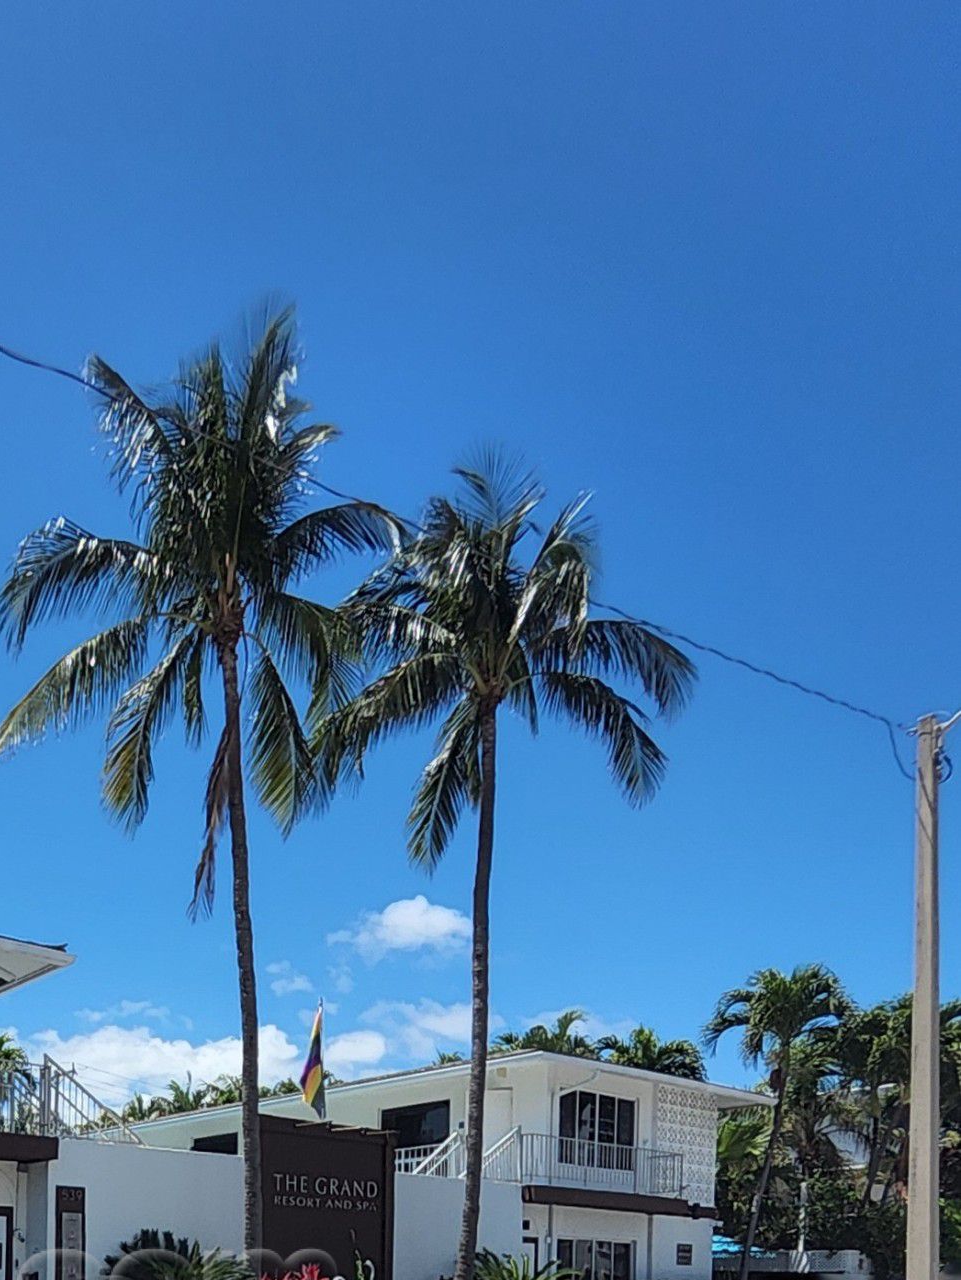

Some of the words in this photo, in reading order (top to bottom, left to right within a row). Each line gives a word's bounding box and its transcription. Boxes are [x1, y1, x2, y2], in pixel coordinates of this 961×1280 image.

[273, 1173, 308, 1193] THE
[315, 1177, 378, 1198] GRAND
[61, 1189, 83, 1201] 539
[274, 1195, 320, 1208] RESORT
[325, 1199, 352, 1210] AND
[356, 1201, 377, 1212] SPA
